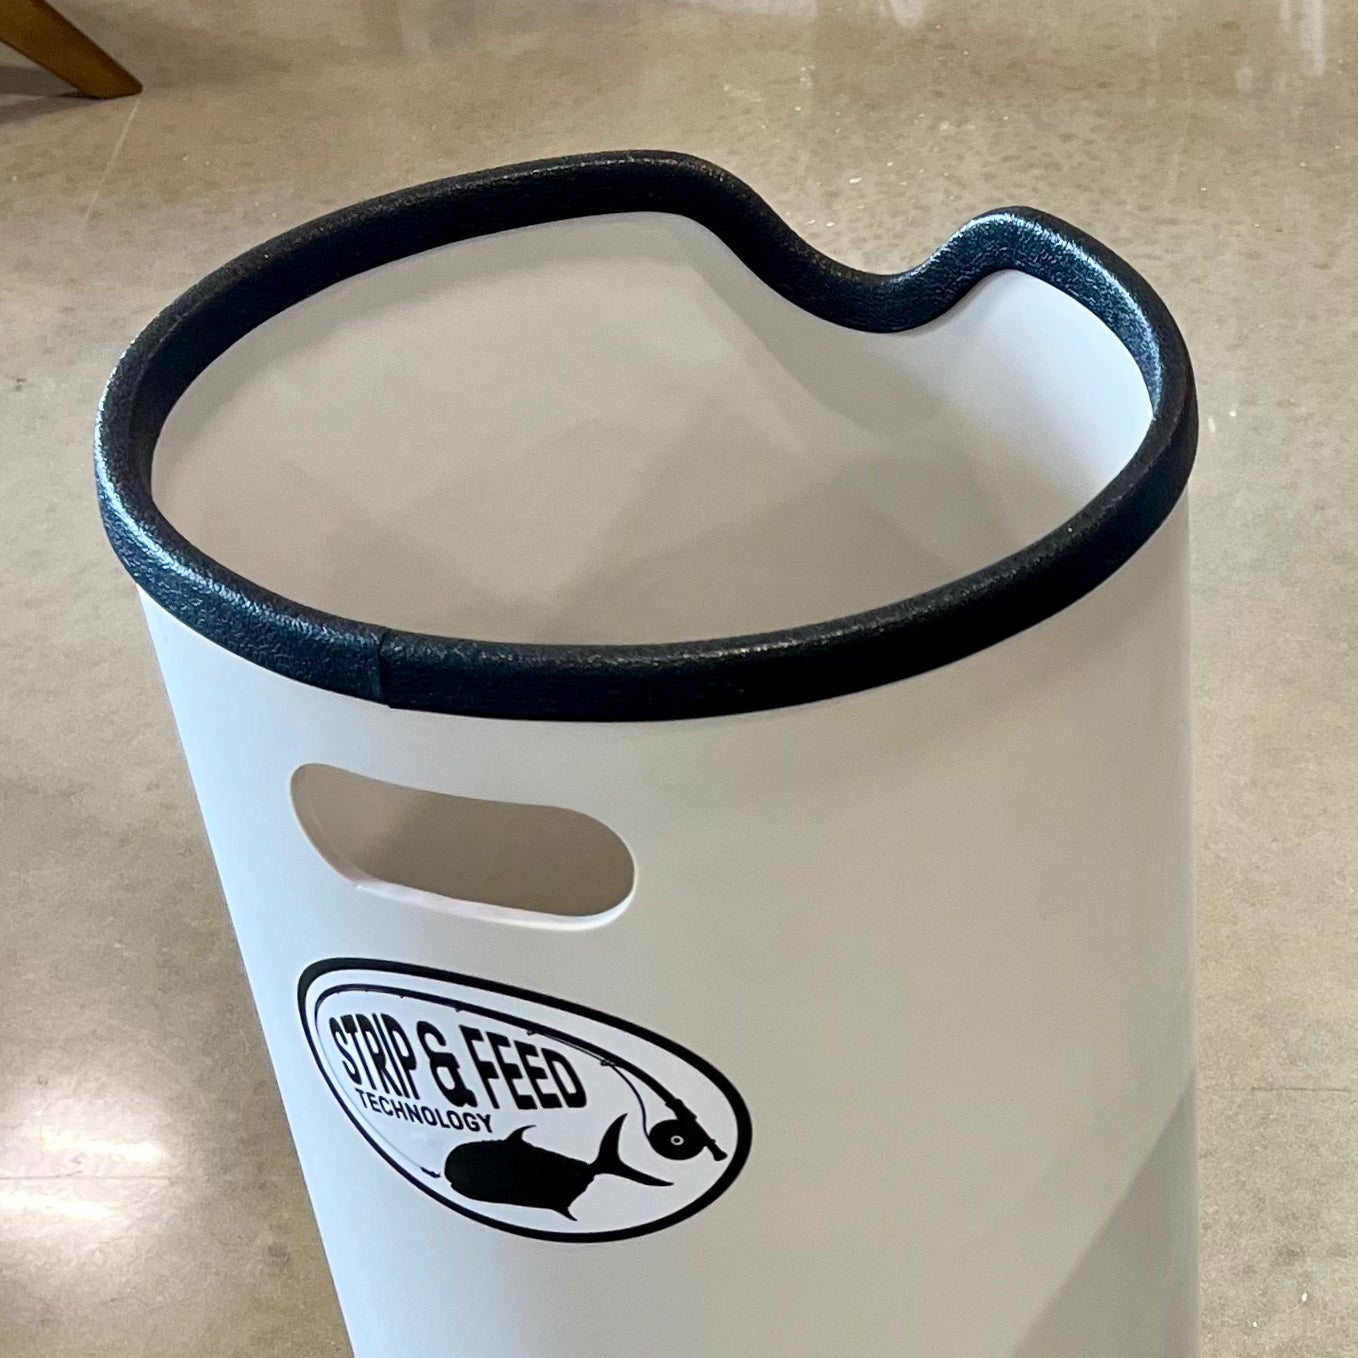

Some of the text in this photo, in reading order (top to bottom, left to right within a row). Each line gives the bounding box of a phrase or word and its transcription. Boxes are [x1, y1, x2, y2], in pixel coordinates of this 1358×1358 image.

[329, 1013, 588, 1110] STRIP & FEED
[354, 1088, 494, 1134] TECHNOLOGY
